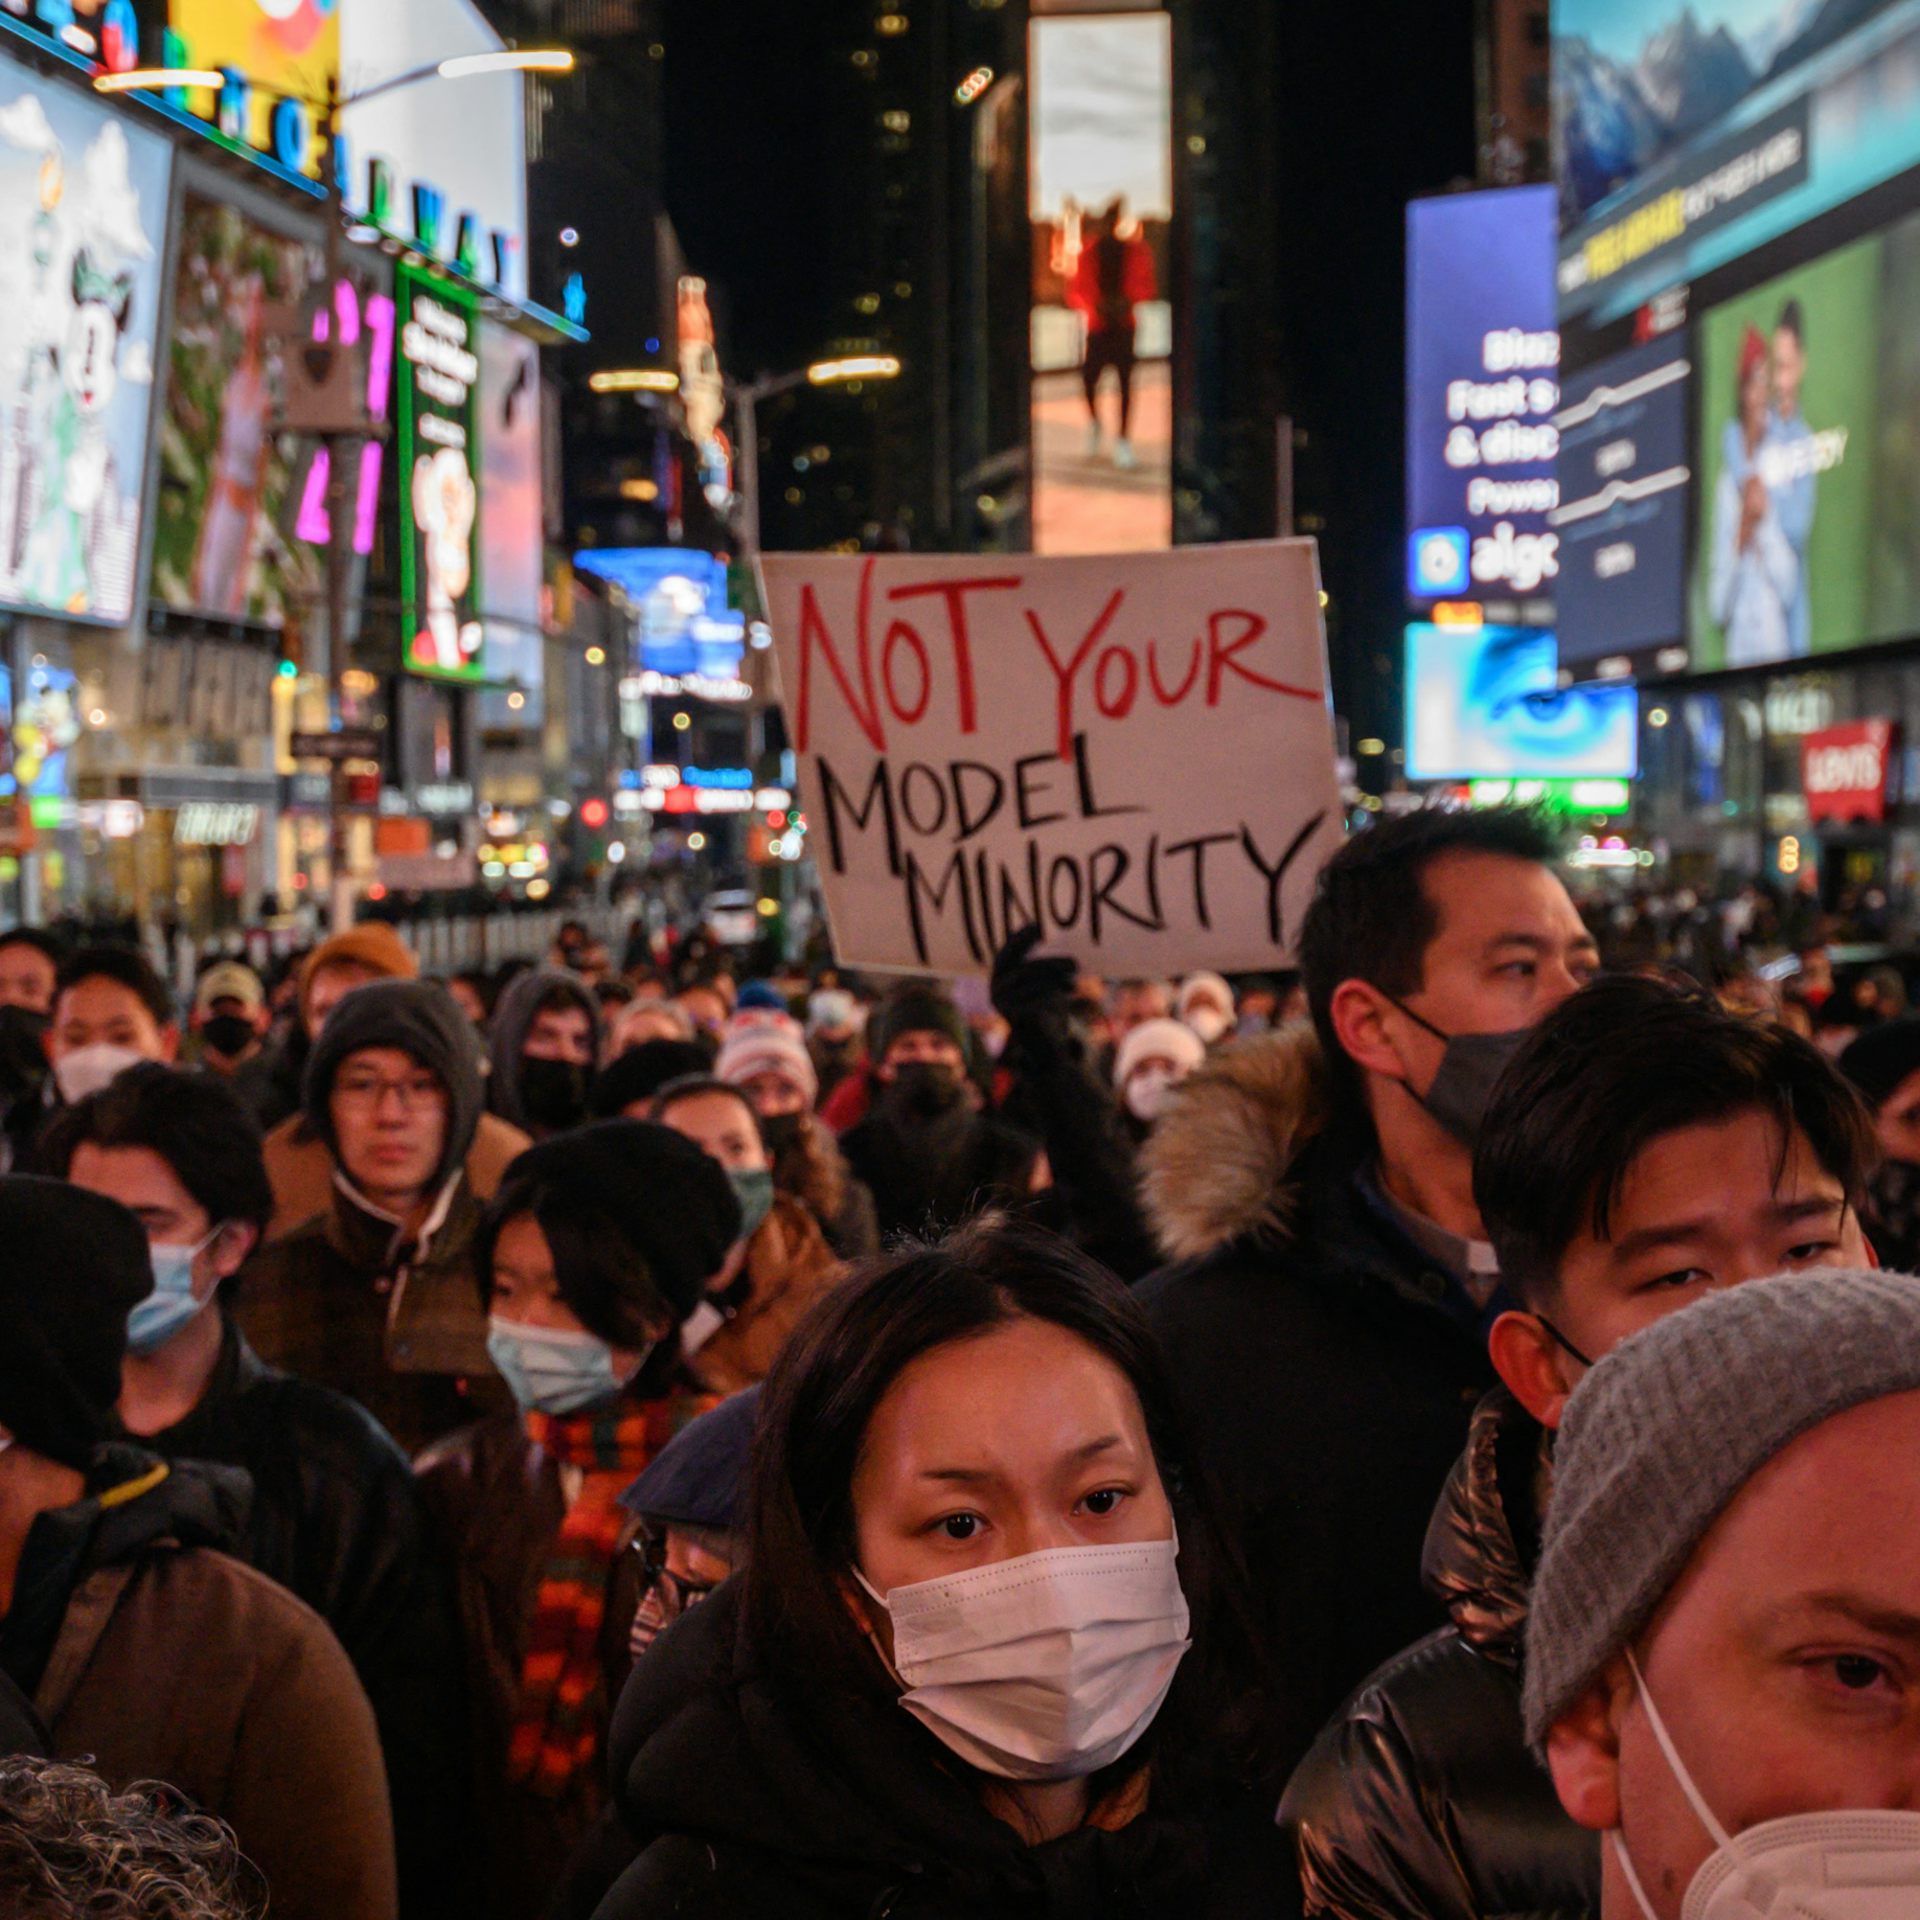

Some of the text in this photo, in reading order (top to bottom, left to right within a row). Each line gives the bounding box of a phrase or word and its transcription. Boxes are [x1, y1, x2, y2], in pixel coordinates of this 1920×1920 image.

[798, 556, 1323, 762] NOT YOUR
[816, 731, 1149, 877] MODEL
[901, 810, 1327, 965] MINORITY
